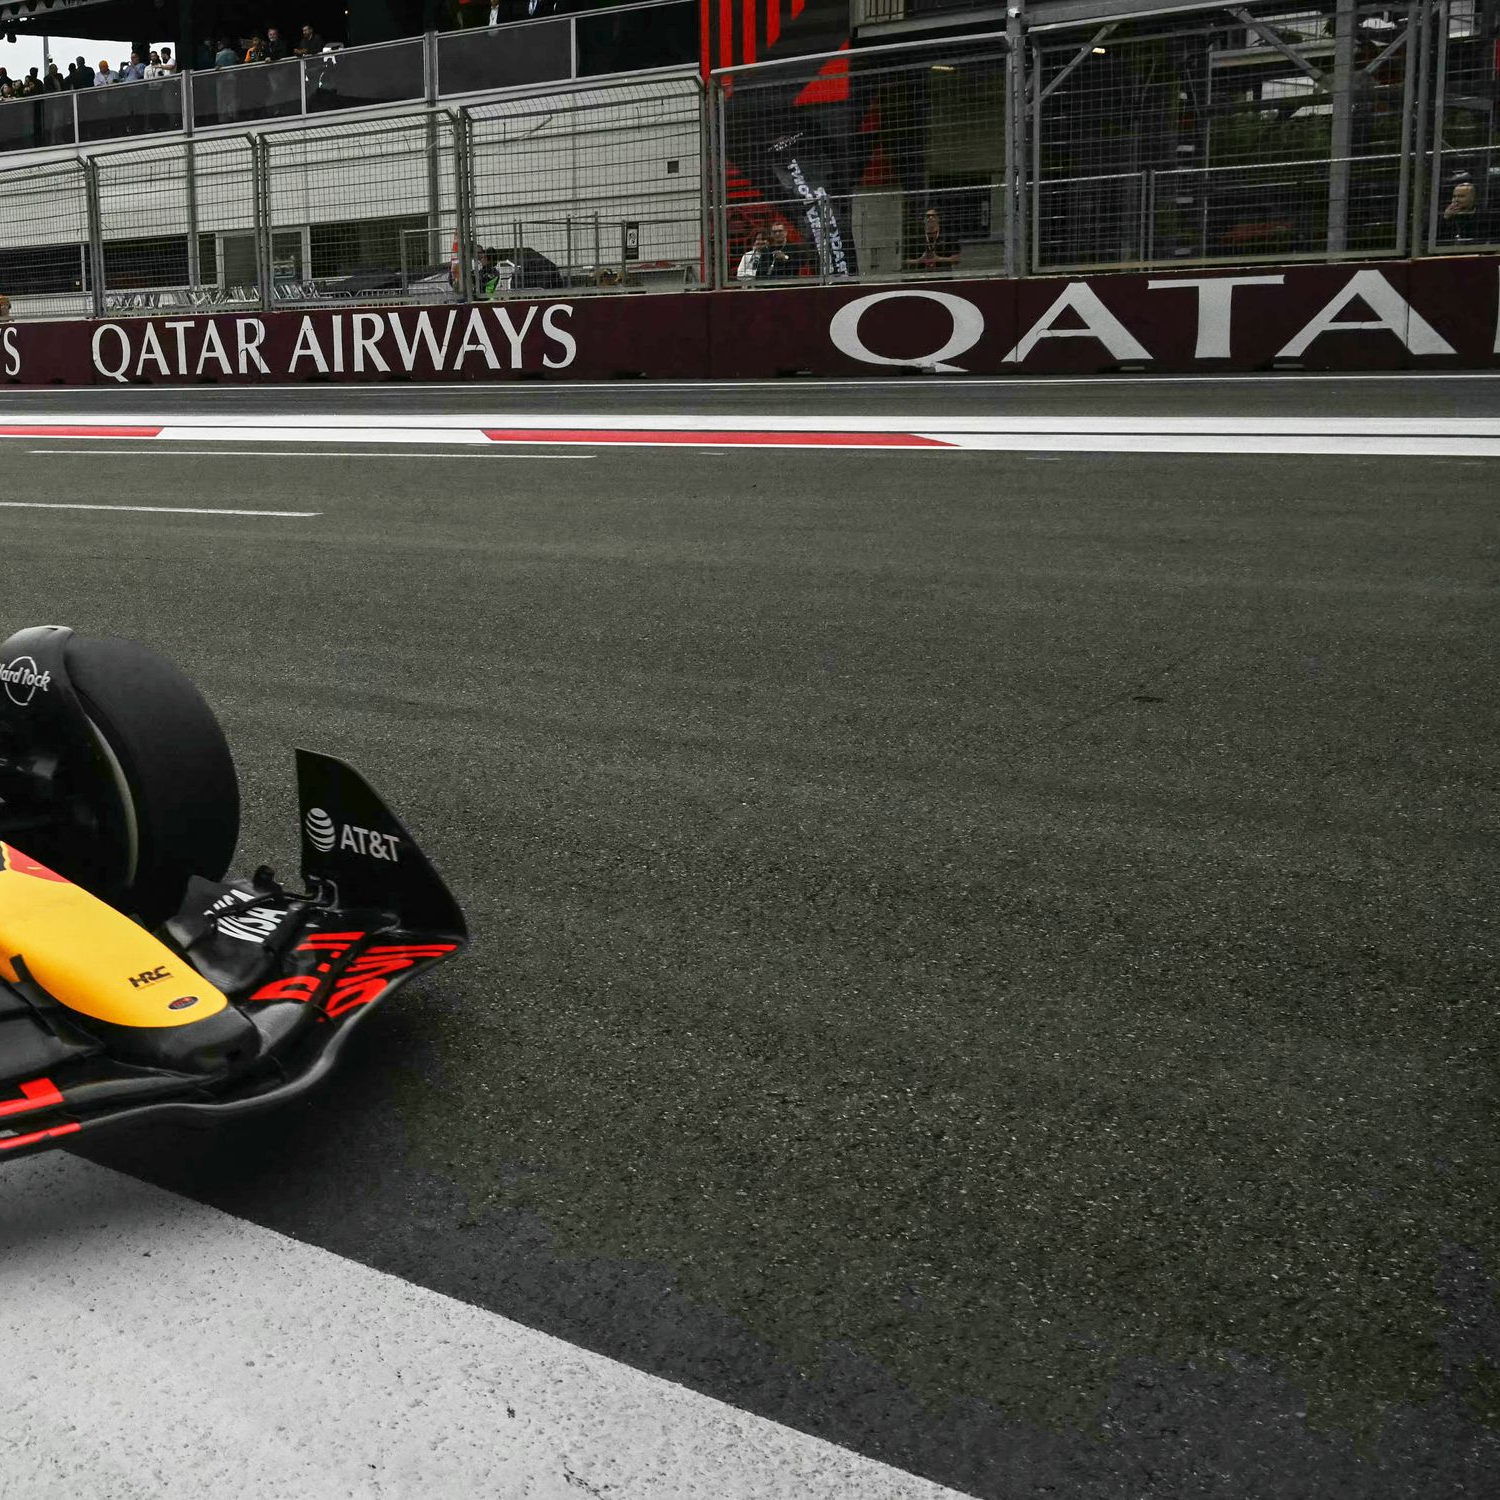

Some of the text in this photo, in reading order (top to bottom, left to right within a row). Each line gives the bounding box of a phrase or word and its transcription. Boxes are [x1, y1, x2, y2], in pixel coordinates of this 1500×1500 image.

[92, 304, 577, 382] QATAR AIRWAYS
[829, 269, 1500, 373] QATA
[340, 823, 400, 862] AT&T
[128, 965, 171, 988] HRC
